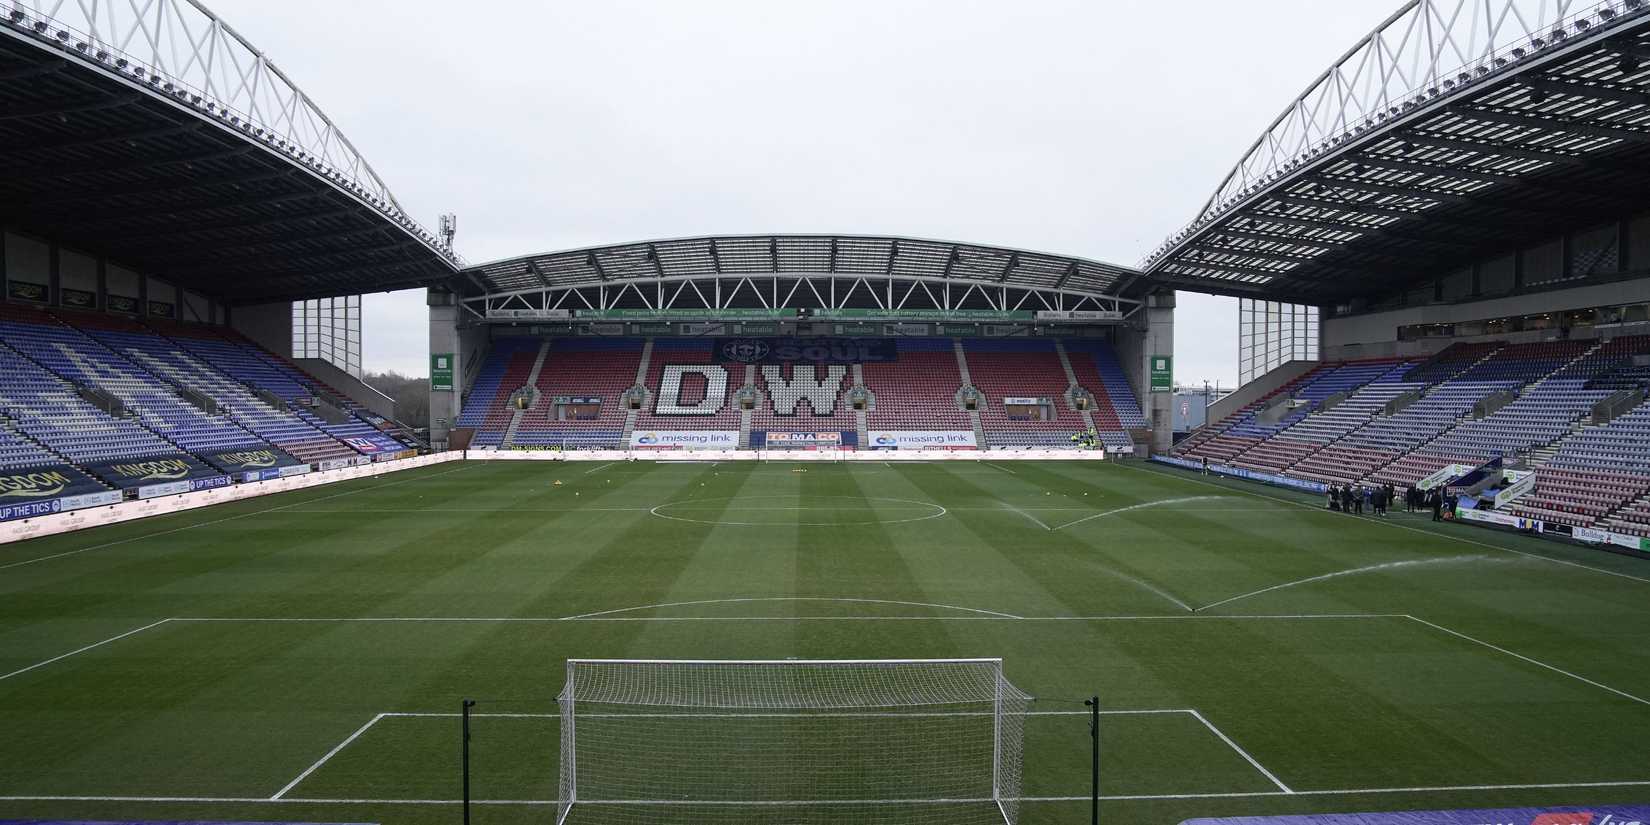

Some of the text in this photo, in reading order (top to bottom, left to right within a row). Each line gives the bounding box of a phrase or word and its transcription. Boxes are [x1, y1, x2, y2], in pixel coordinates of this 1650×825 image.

[661, 434, 730, 445] missing link
[898, 434, 968, 445] missing link
[217, 449, 278, 465] KINGDOM
[111, 459, 193, 478] KINGDOM
[0, 471, 72, 492] GDOM
[196, 480, 204, 489] UP
[214, 477, 226, 486] TICS
[0, 503, 50, 520] UP THE TICS
